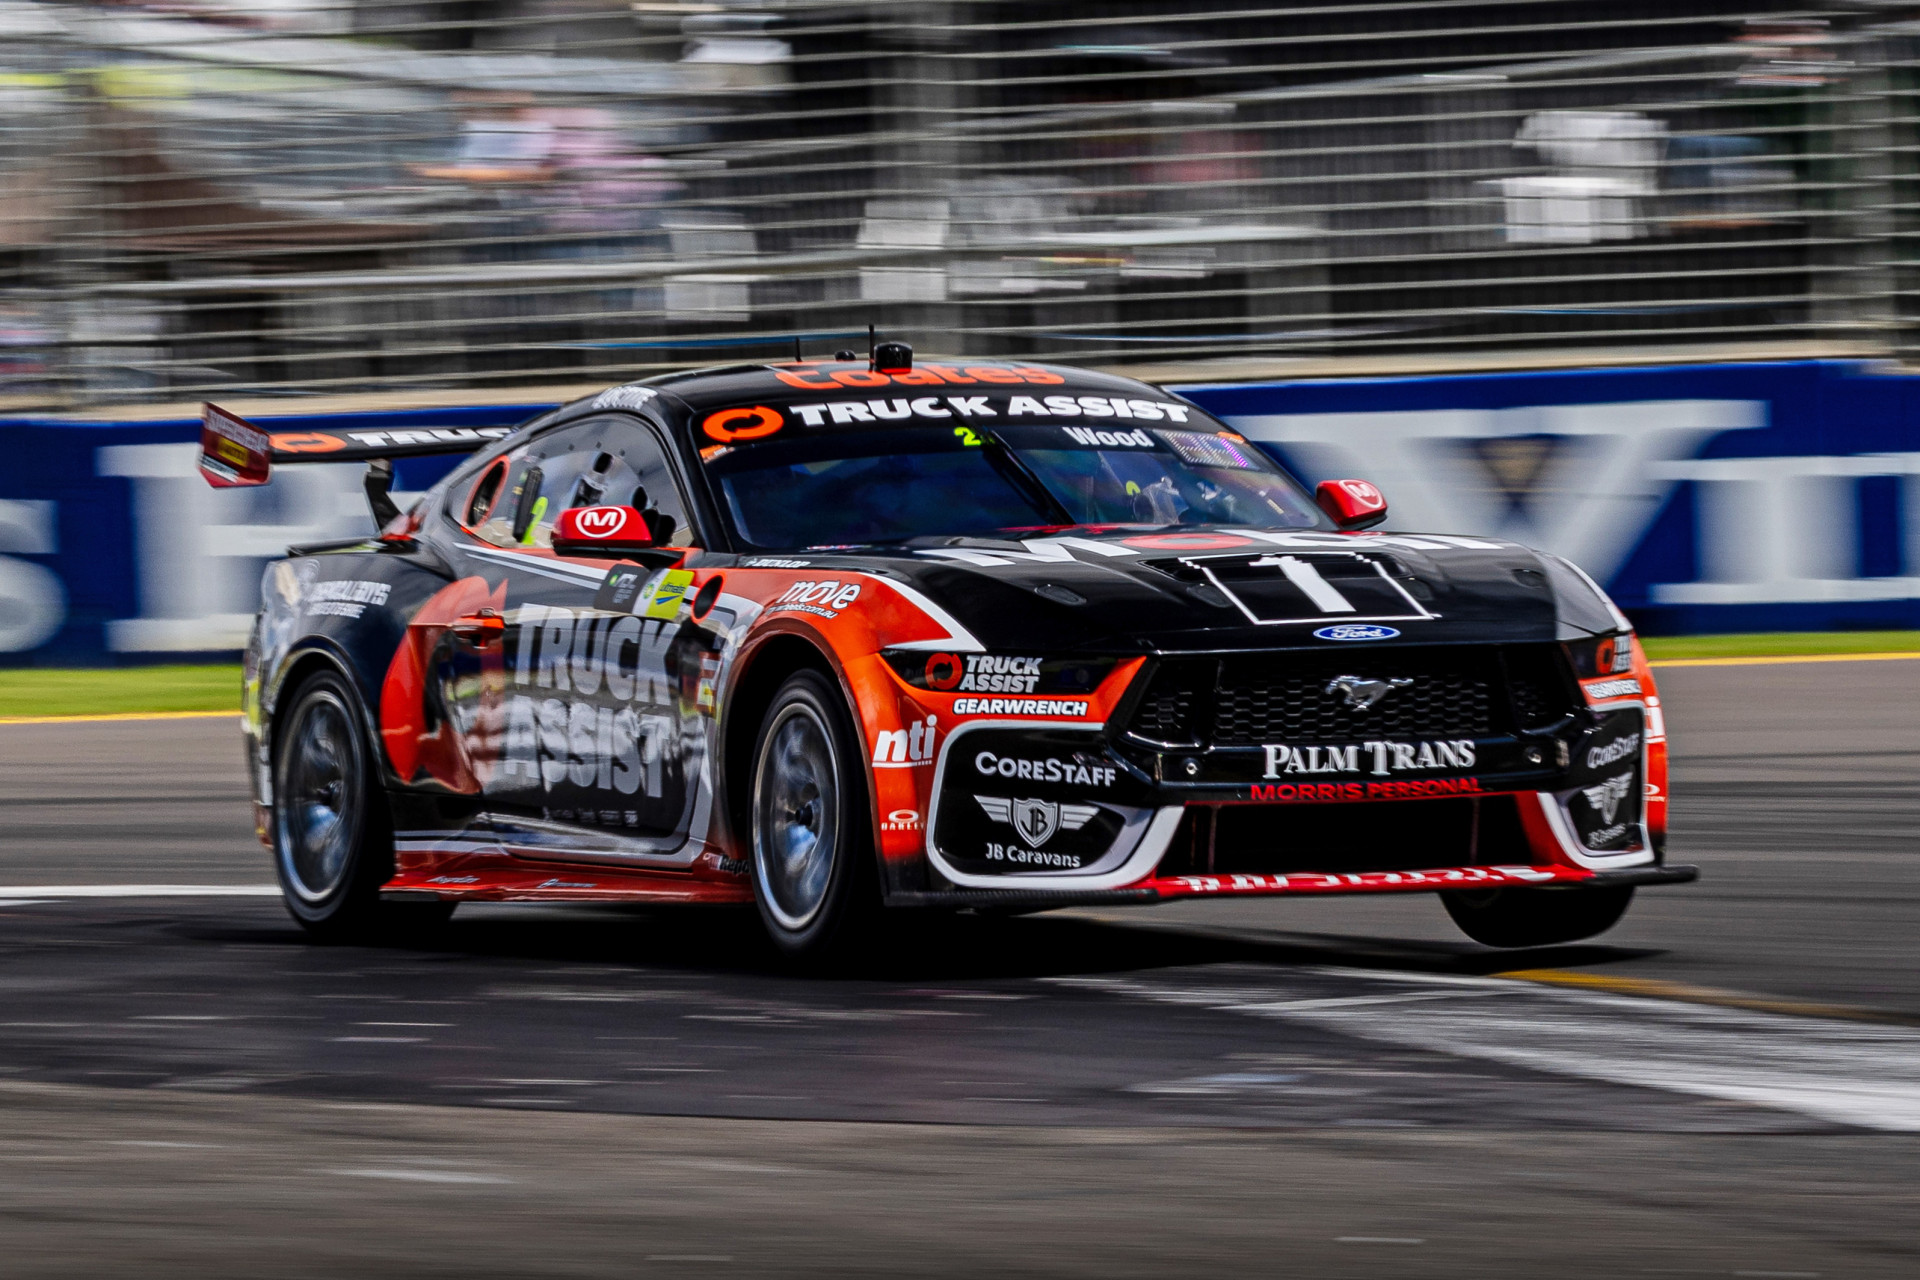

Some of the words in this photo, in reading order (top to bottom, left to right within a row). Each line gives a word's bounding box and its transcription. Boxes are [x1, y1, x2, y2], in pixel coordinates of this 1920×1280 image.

[775, 366, 1065, 390] Coates
[788, 396, 997, 426] TRUCK
[1008, 395, 1189, 422] ASSIST
[1062, 426, 1154, 447] Wood
[775, 580, 861, 610] move
[514, 602, 681, 706] TRUCK
[966, 655, 1043, 676] TRUCK
[959, 672, 1039, 694] ASSIST
[953, 697, 1089, 717] GEARWRENCH
[502, 694, 671, 799] ASSIST
[873, 714, 938, 762] nti
[1261, 744, 1361, 780] PALM
[1363, 740, 1477, 776] TRANS
[1250, 782, 1365, 801] MORRIS
[1366, 776, 1484, 798] PERSONAL
[984, 842, 1005, 861] JB
[1005, 845, 1082, 868] Caravans
